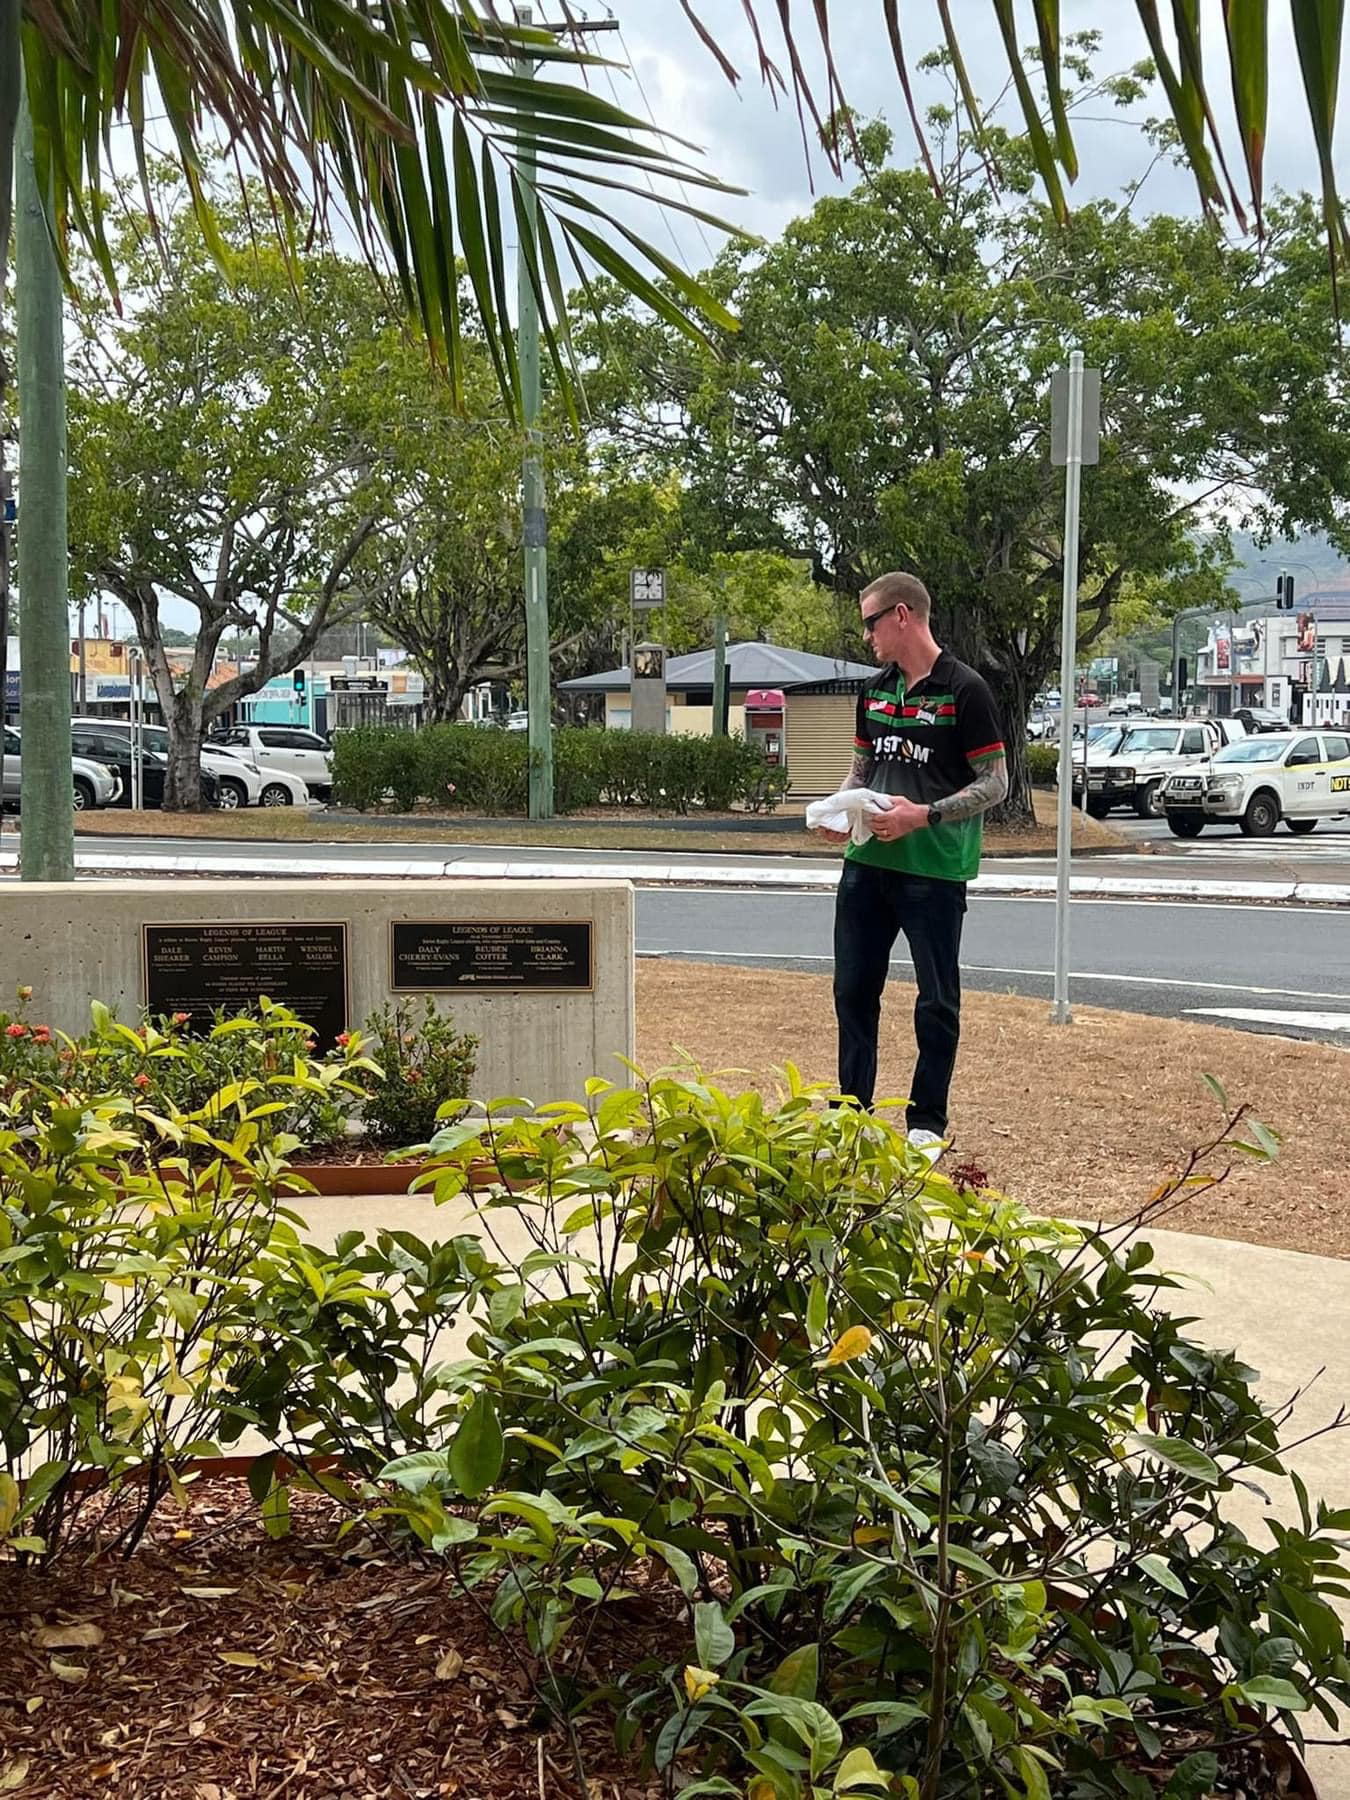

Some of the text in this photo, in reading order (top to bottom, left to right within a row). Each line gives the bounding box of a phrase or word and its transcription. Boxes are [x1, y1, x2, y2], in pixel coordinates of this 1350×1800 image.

[203, 929, 239, 937] LEGENDS
[255, 928, 287, 936] LEAGUE
[452, 926, 534, 935] LEGENDS OF LEAGUE
[161, 946, 183, 954] DALE
[300, 945, 338, 953] WENDELL
[531, 945, 568, 953] BRIANNA
[153, 954, 190, 962] SHEARER
[203, 953, 239, 961] CAMPION
[258, 953, 284, 961] BELLA
[306, 953, 333, 961] SAILOR
[398, 953, 460, 961] CHERRY-EVANS
[475, 953, 508, 961] COTTER
[535, 952, 563, 960] CLARK
